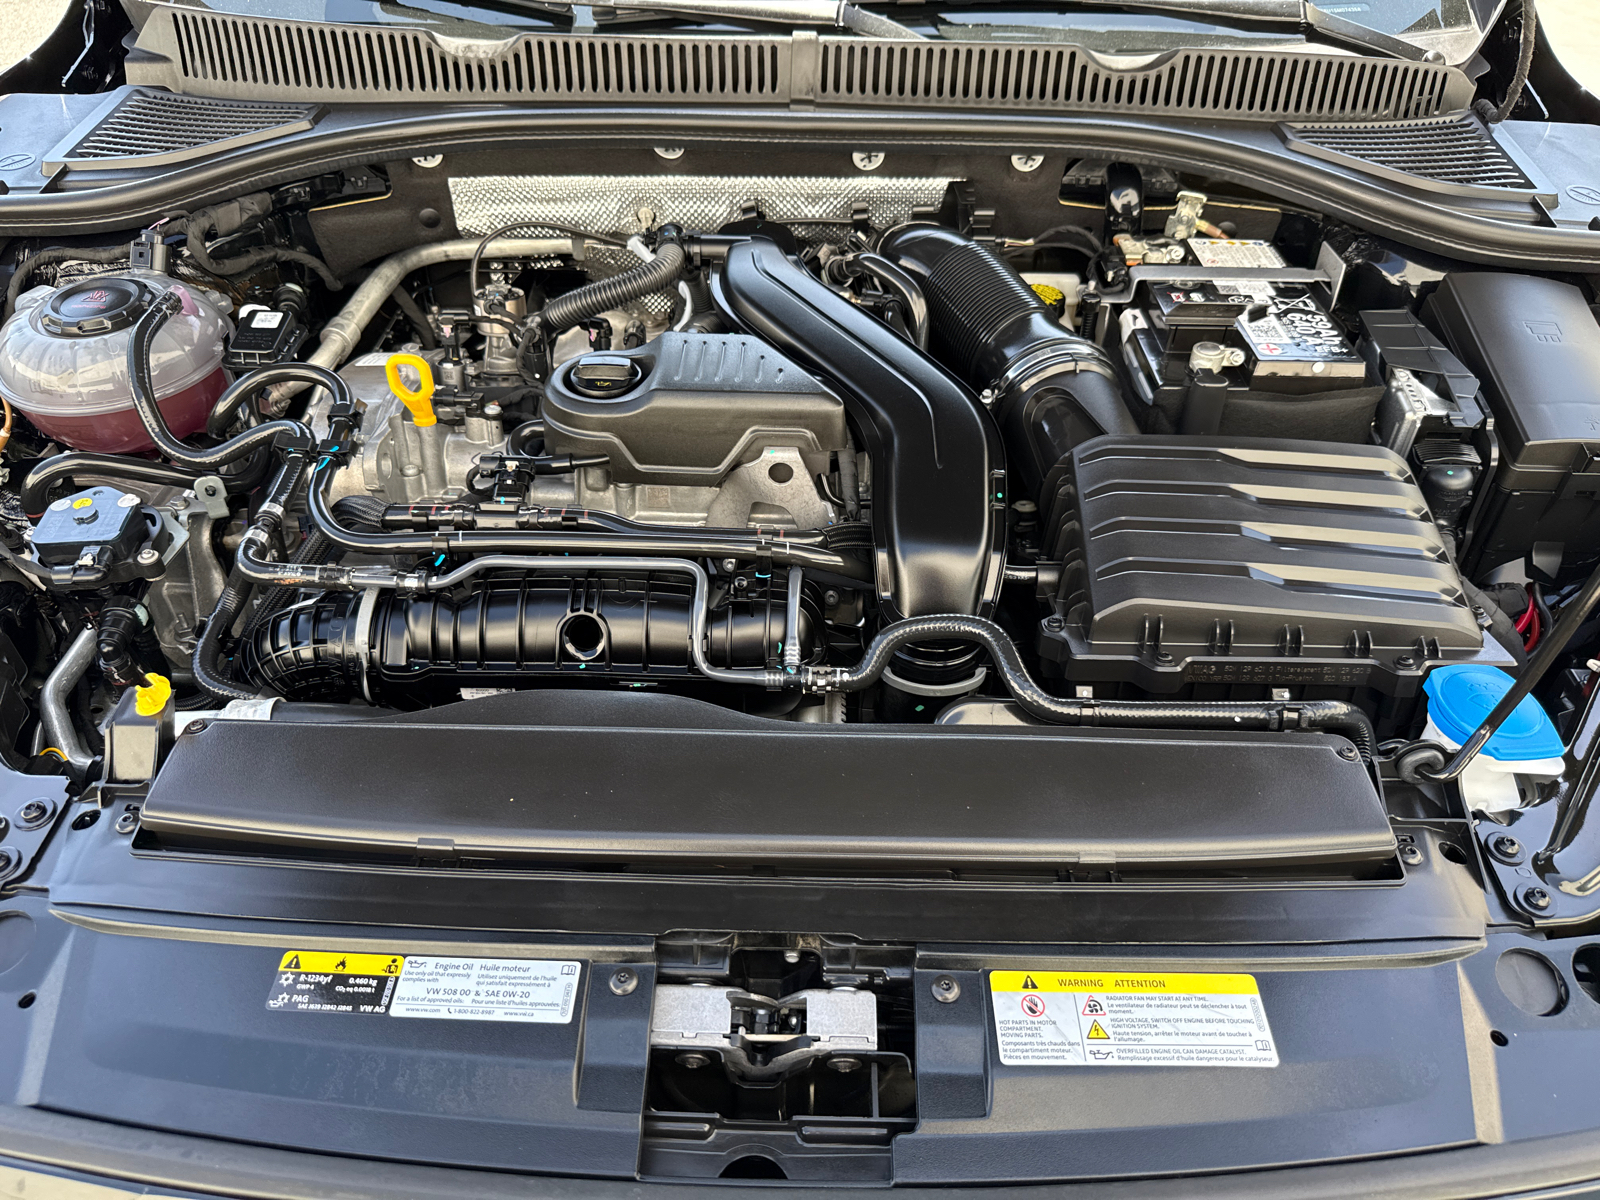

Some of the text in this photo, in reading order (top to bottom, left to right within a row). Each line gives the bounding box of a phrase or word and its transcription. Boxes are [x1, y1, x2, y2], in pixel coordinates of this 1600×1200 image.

[1286, 312, 1317, 334] 640
[1302, 336, 1324, 346] A
[1306, 314, 1342, 344] 59Ah
[434, 962, 461, 971] Engine
[300, 974, 333, 984] R-1234yf
[1057, 979, 1166, 988] WARNING ATTENTION
